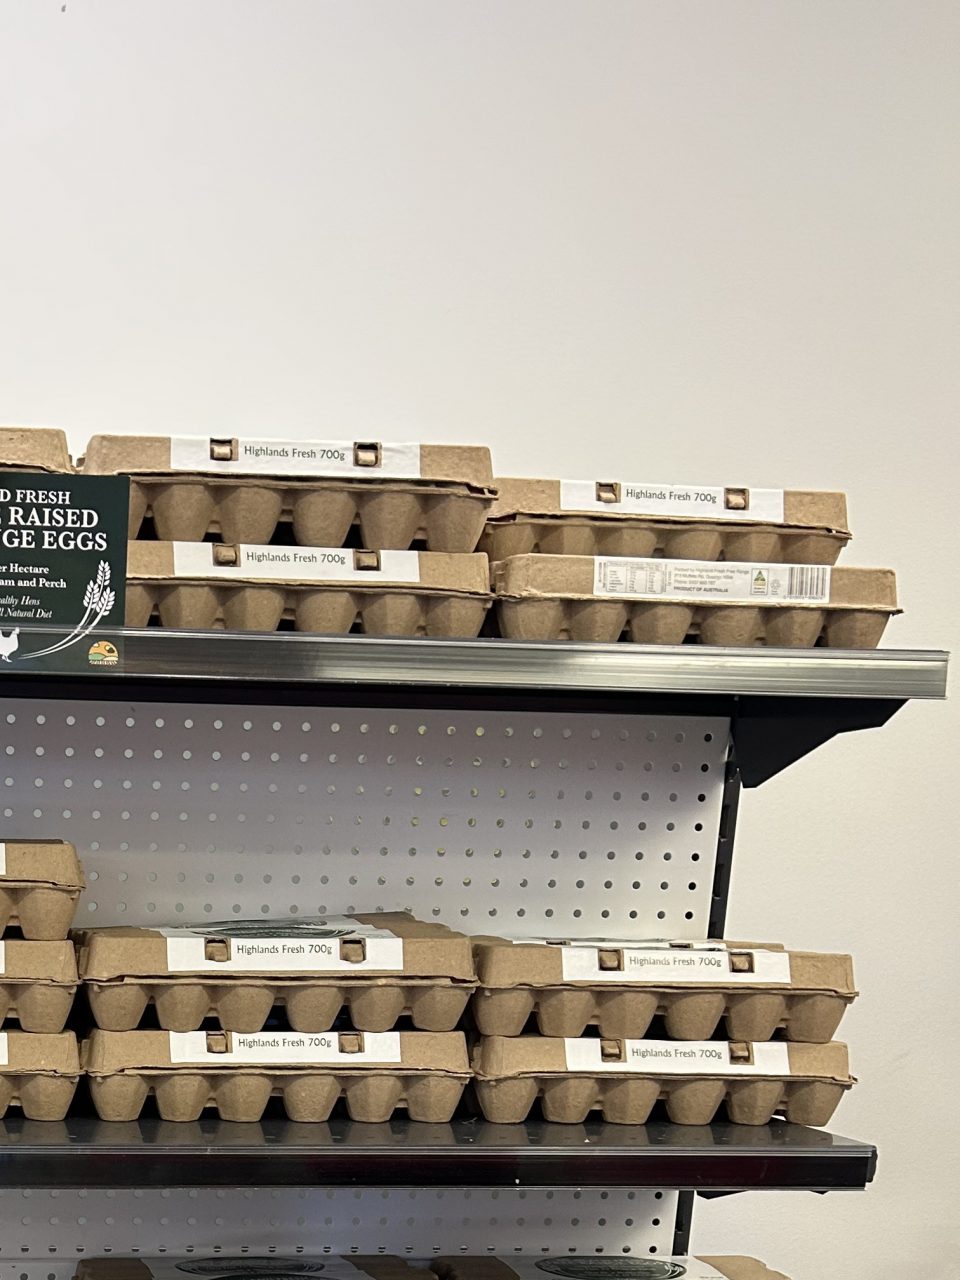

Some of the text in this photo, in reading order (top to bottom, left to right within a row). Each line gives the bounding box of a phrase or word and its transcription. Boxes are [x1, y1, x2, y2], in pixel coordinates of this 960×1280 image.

[244, 446, 345, 461] Highlands Fresh 700g
[15, 489, 71, 504] FRESH
[626, 489, 716, 504] Highlands Fresh 700g
[9, 507, 98, 528] RAISED
[42, 531, 107, 551] EGGS
[247, 552, 345, 564] Highlands Fresh 700g
[9, 563, 49, 574] Hectare
[17, 578, 37, 587] and
[39, 578, 66, 588] Perch
[21, 596, 40, 606] Hens
[4, 608, 34, 618] Natural
[36, 609, 52, 618] Diet
[237, 944, 332, 955] Highlands Fresh 700g
[632, 1048, 722, 1059] Highlands Fresh 700g
